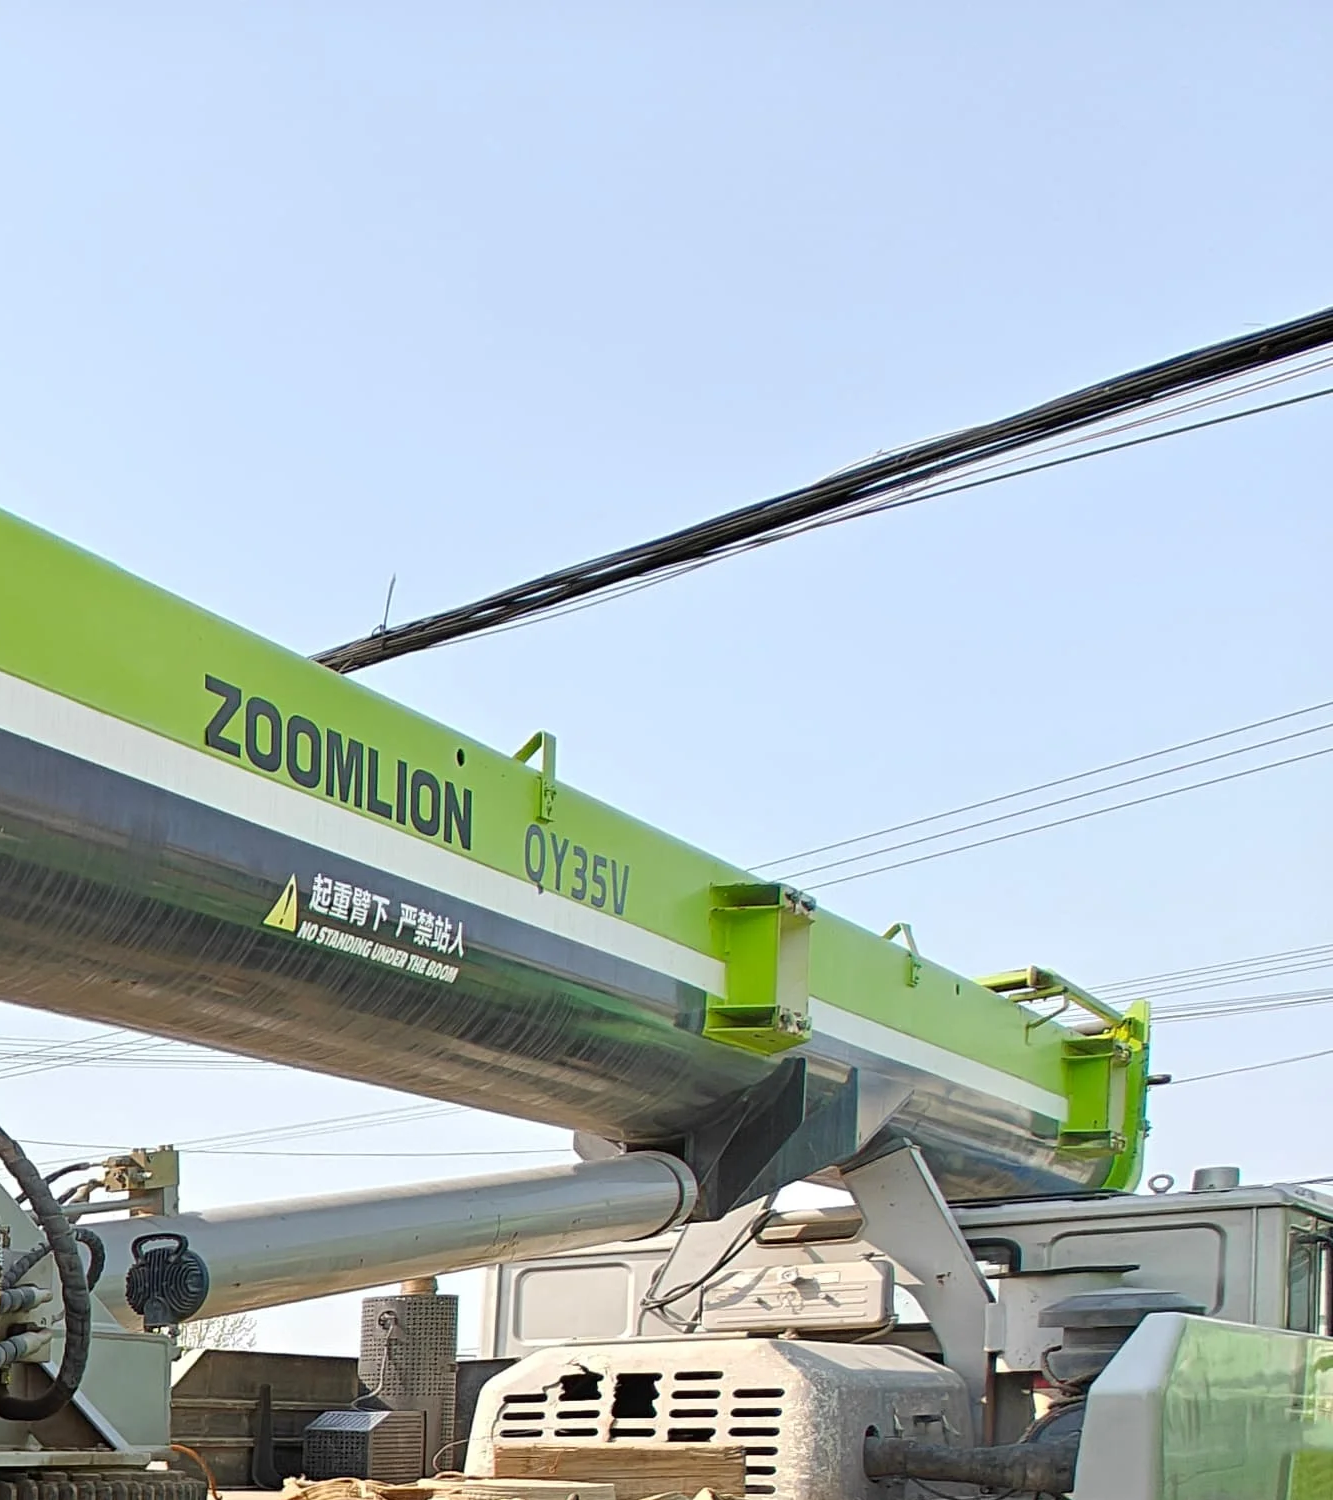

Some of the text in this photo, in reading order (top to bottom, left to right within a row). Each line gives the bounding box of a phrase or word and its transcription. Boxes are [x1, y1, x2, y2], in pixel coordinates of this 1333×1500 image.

[205, 674, 472, 850] ZOOMLION
[525, 824, 630, 915] QY35V
[296, 920, 459, 984] NO STANDING UNDER THE BOOM
[309, 873, 465, 958] 起重臂下 严禁站人
